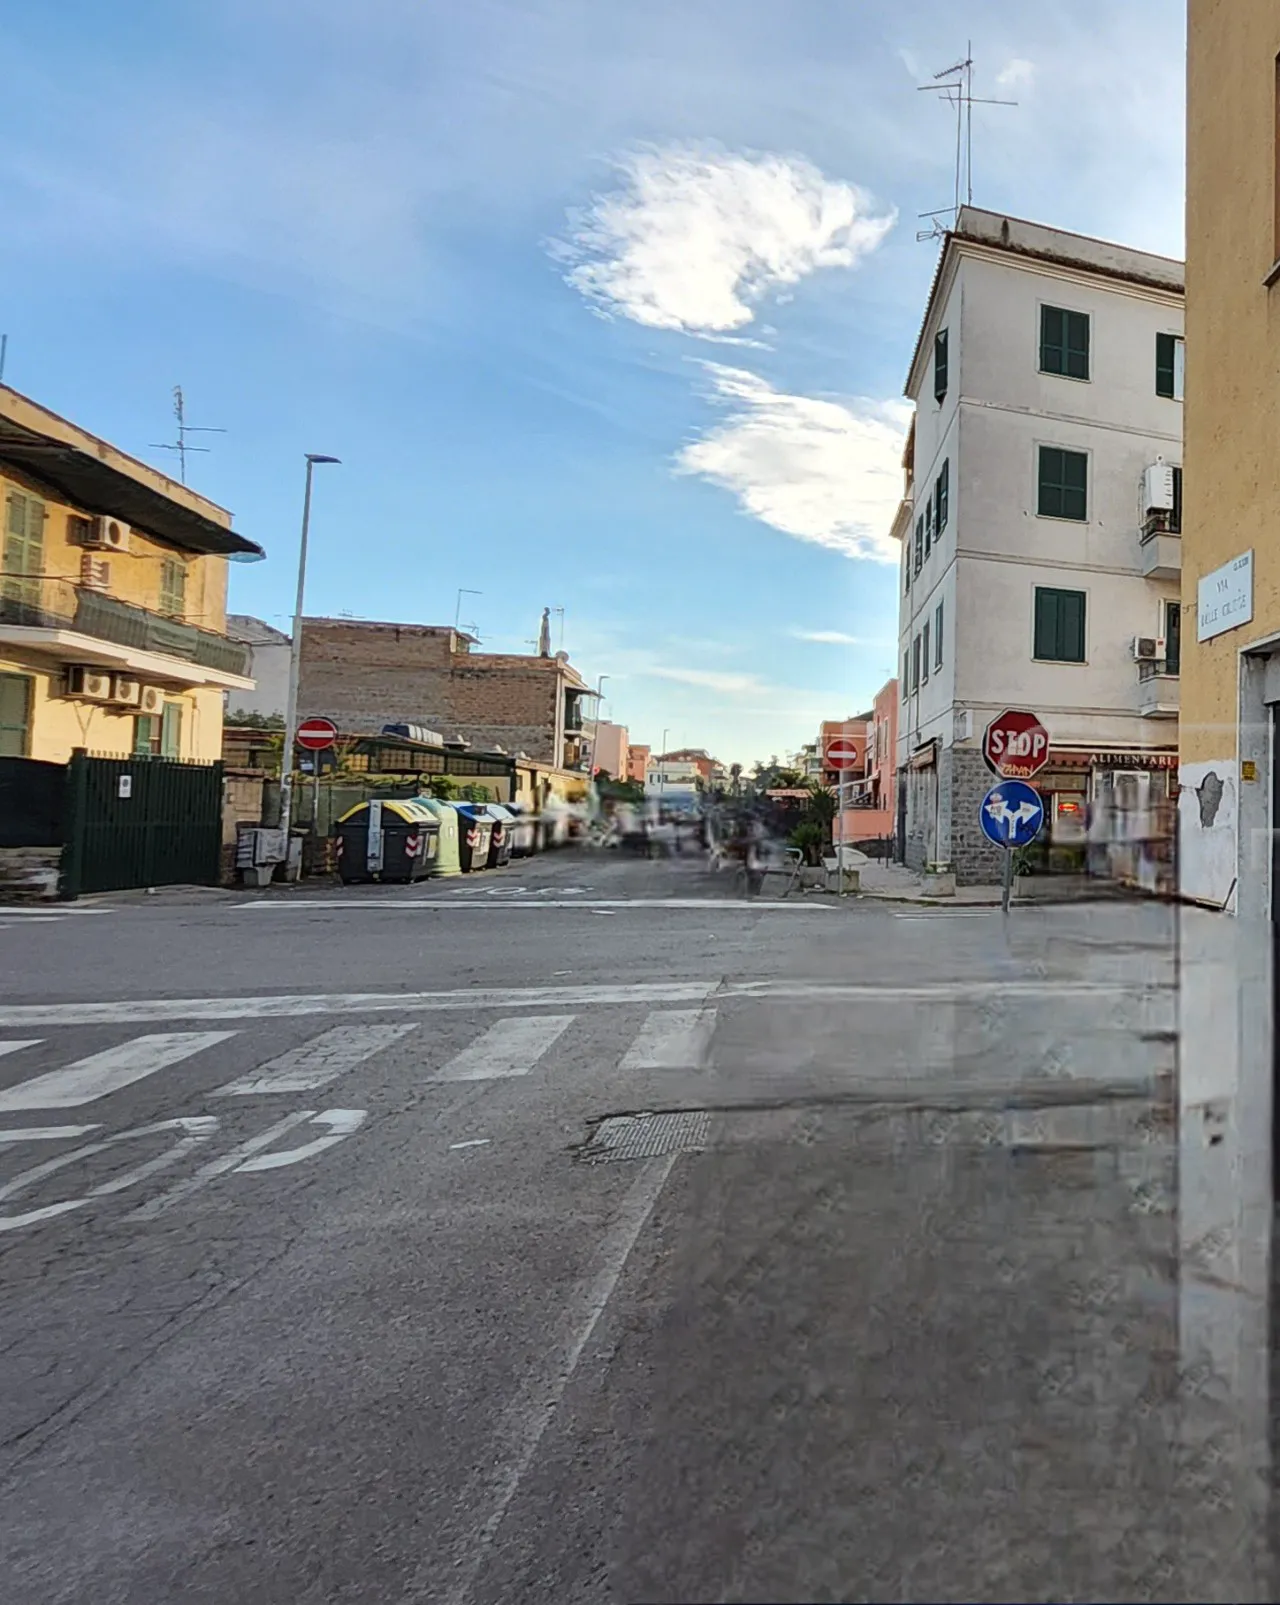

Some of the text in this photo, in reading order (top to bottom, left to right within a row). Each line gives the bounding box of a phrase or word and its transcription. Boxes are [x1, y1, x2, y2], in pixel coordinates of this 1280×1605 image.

[1216, 578, 1228, 593] VIA
[990, 729, 1046, 758] STOP
[1089, 754, 1172, 766] ALIMENTARI
